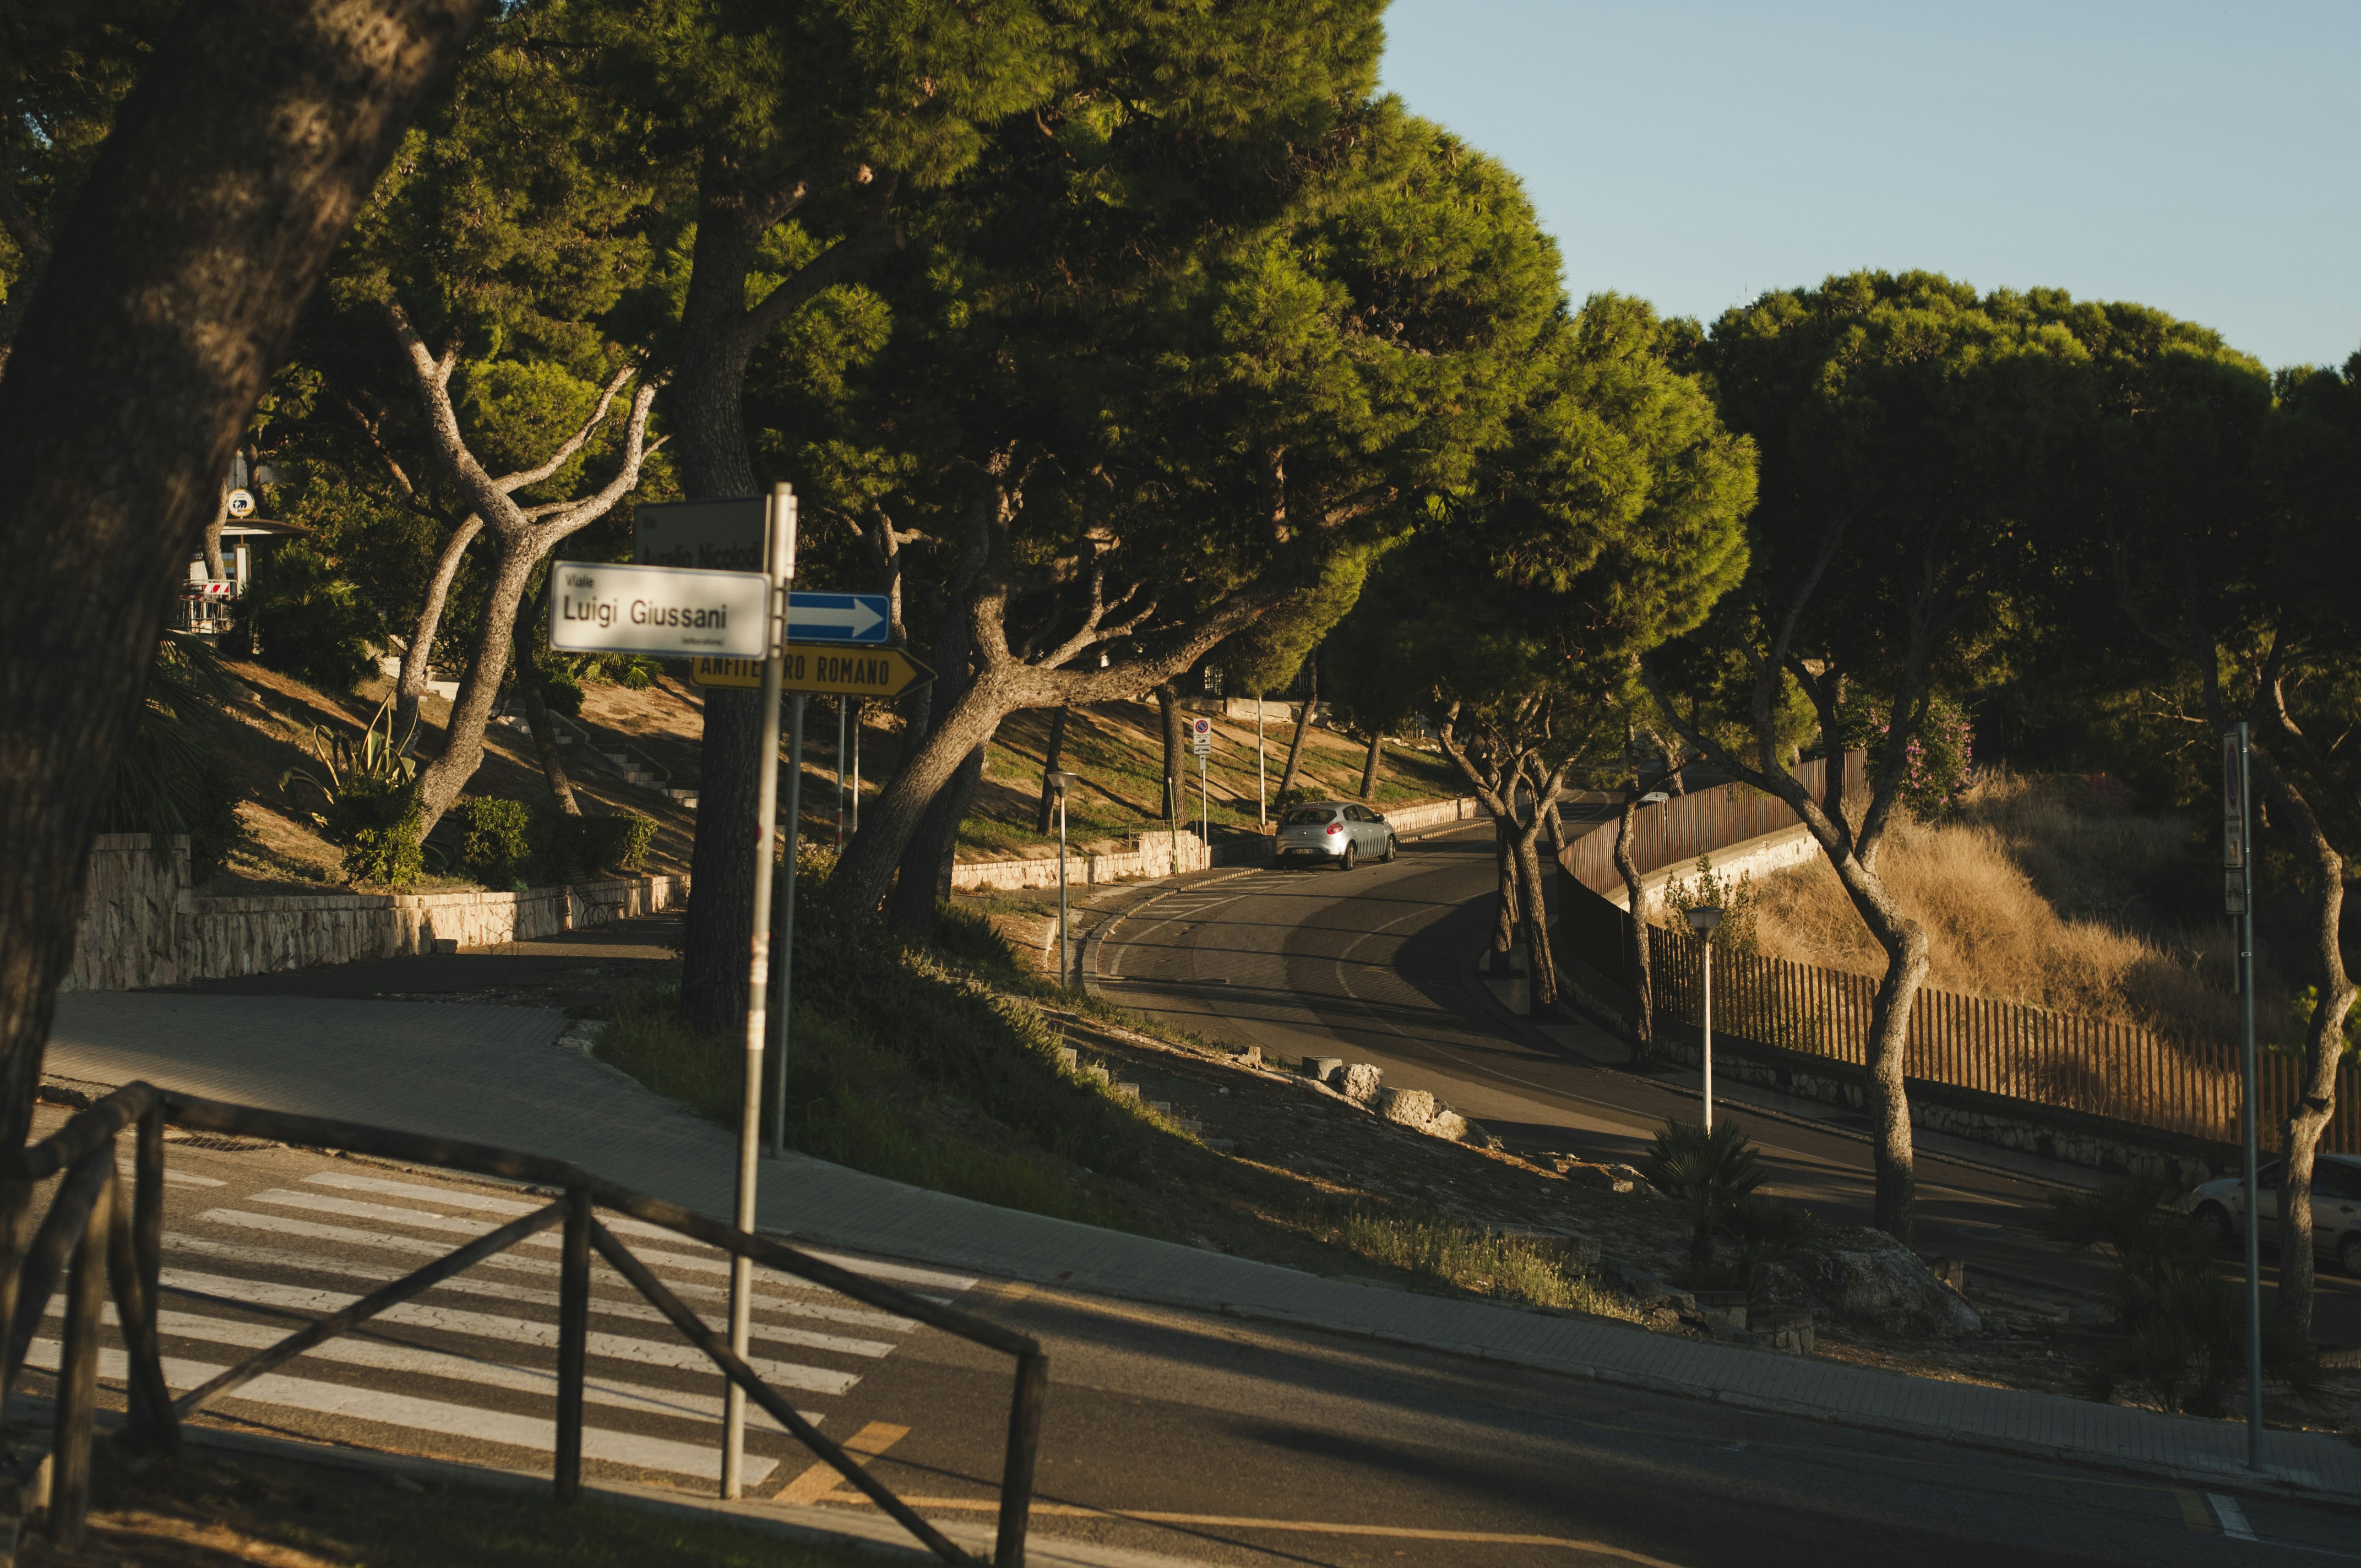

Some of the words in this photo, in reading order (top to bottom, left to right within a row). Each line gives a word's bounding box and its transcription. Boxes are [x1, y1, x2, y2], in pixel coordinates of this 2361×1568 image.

[565, 574, 595, 589] Viale
[564, 595, 618, 628] Luigi
[631, 600, 727, 629] Giussani
[700, 654, 804, 680] ANFITERO
[817, 656, 889, 685] ROMANO
